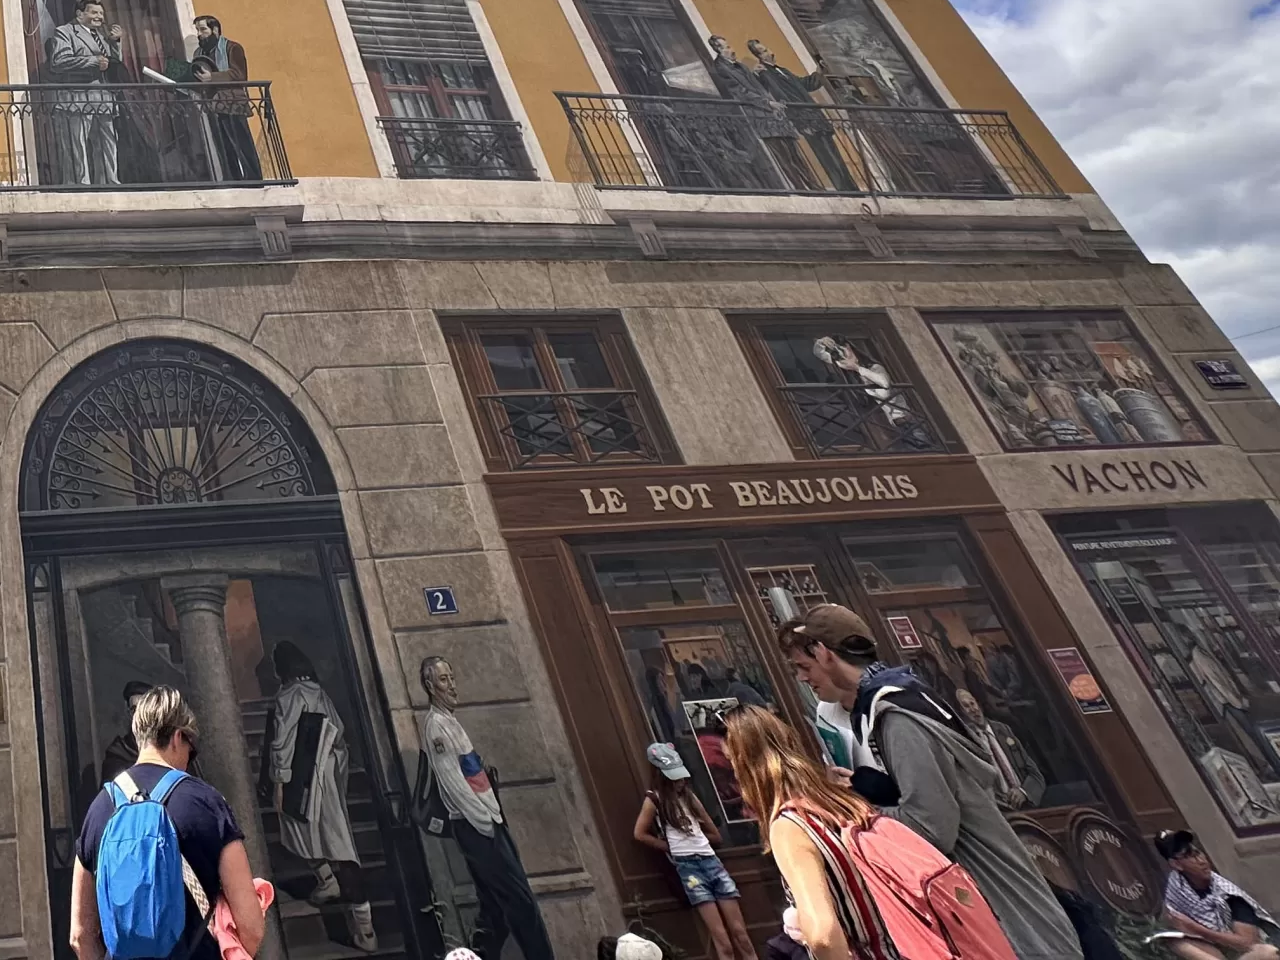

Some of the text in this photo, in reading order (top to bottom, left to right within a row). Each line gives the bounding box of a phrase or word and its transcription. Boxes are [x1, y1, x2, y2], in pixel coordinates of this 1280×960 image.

[580, 474, 919, 515] LE POT BEAUJOLAIS
[1050, 458, 1208, 495] VACHON
[436, 592, 447, 609] 2
